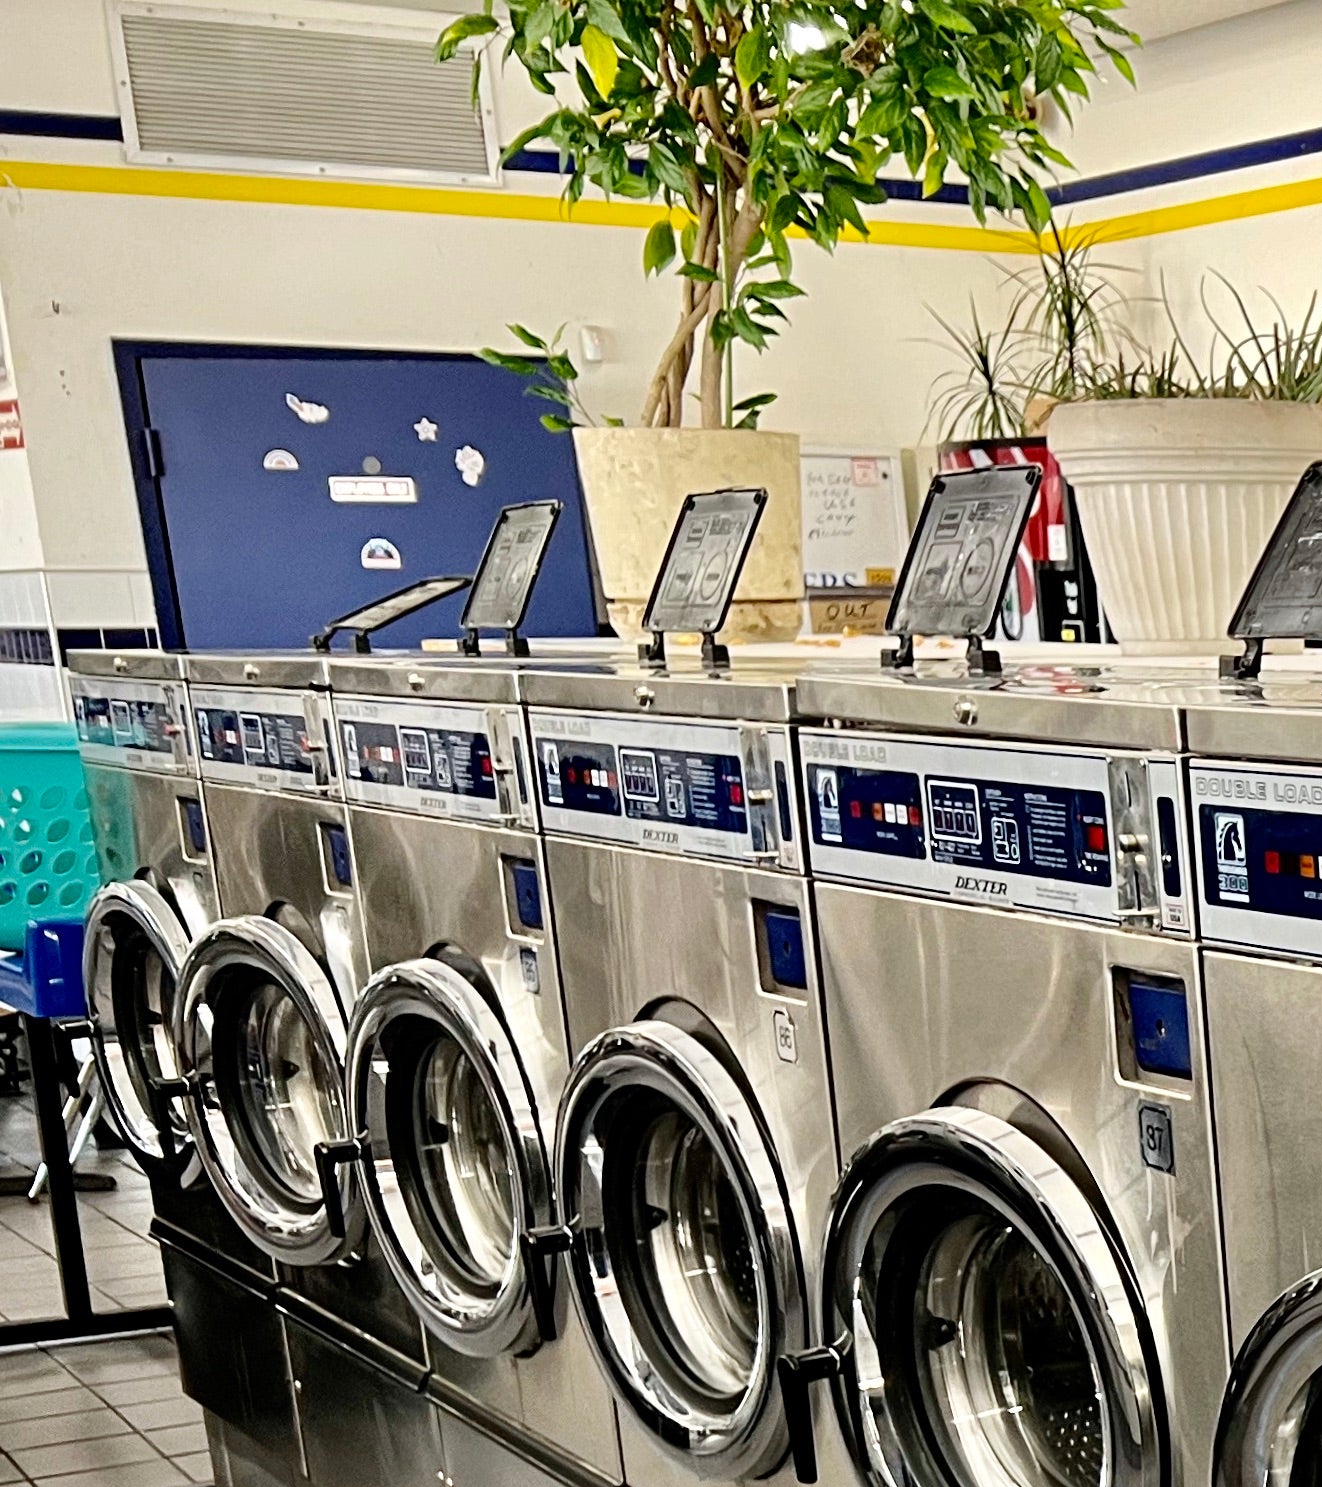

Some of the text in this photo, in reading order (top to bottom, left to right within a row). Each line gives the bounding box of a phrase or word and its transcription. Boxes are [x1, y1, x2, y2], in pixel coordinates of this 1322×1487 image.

[826, 601, 874, 621] OUT
[853, 745, 886, 763] LOAD
[1195, 777, 1267, 800] DOUBLE
[642, 828, 679, 844] DEXTER
[955, 876, 1008, 895] DEXTER
[1218, 874, 1249, 893] 300
[1146, 1124, 1164, 1151] 87
